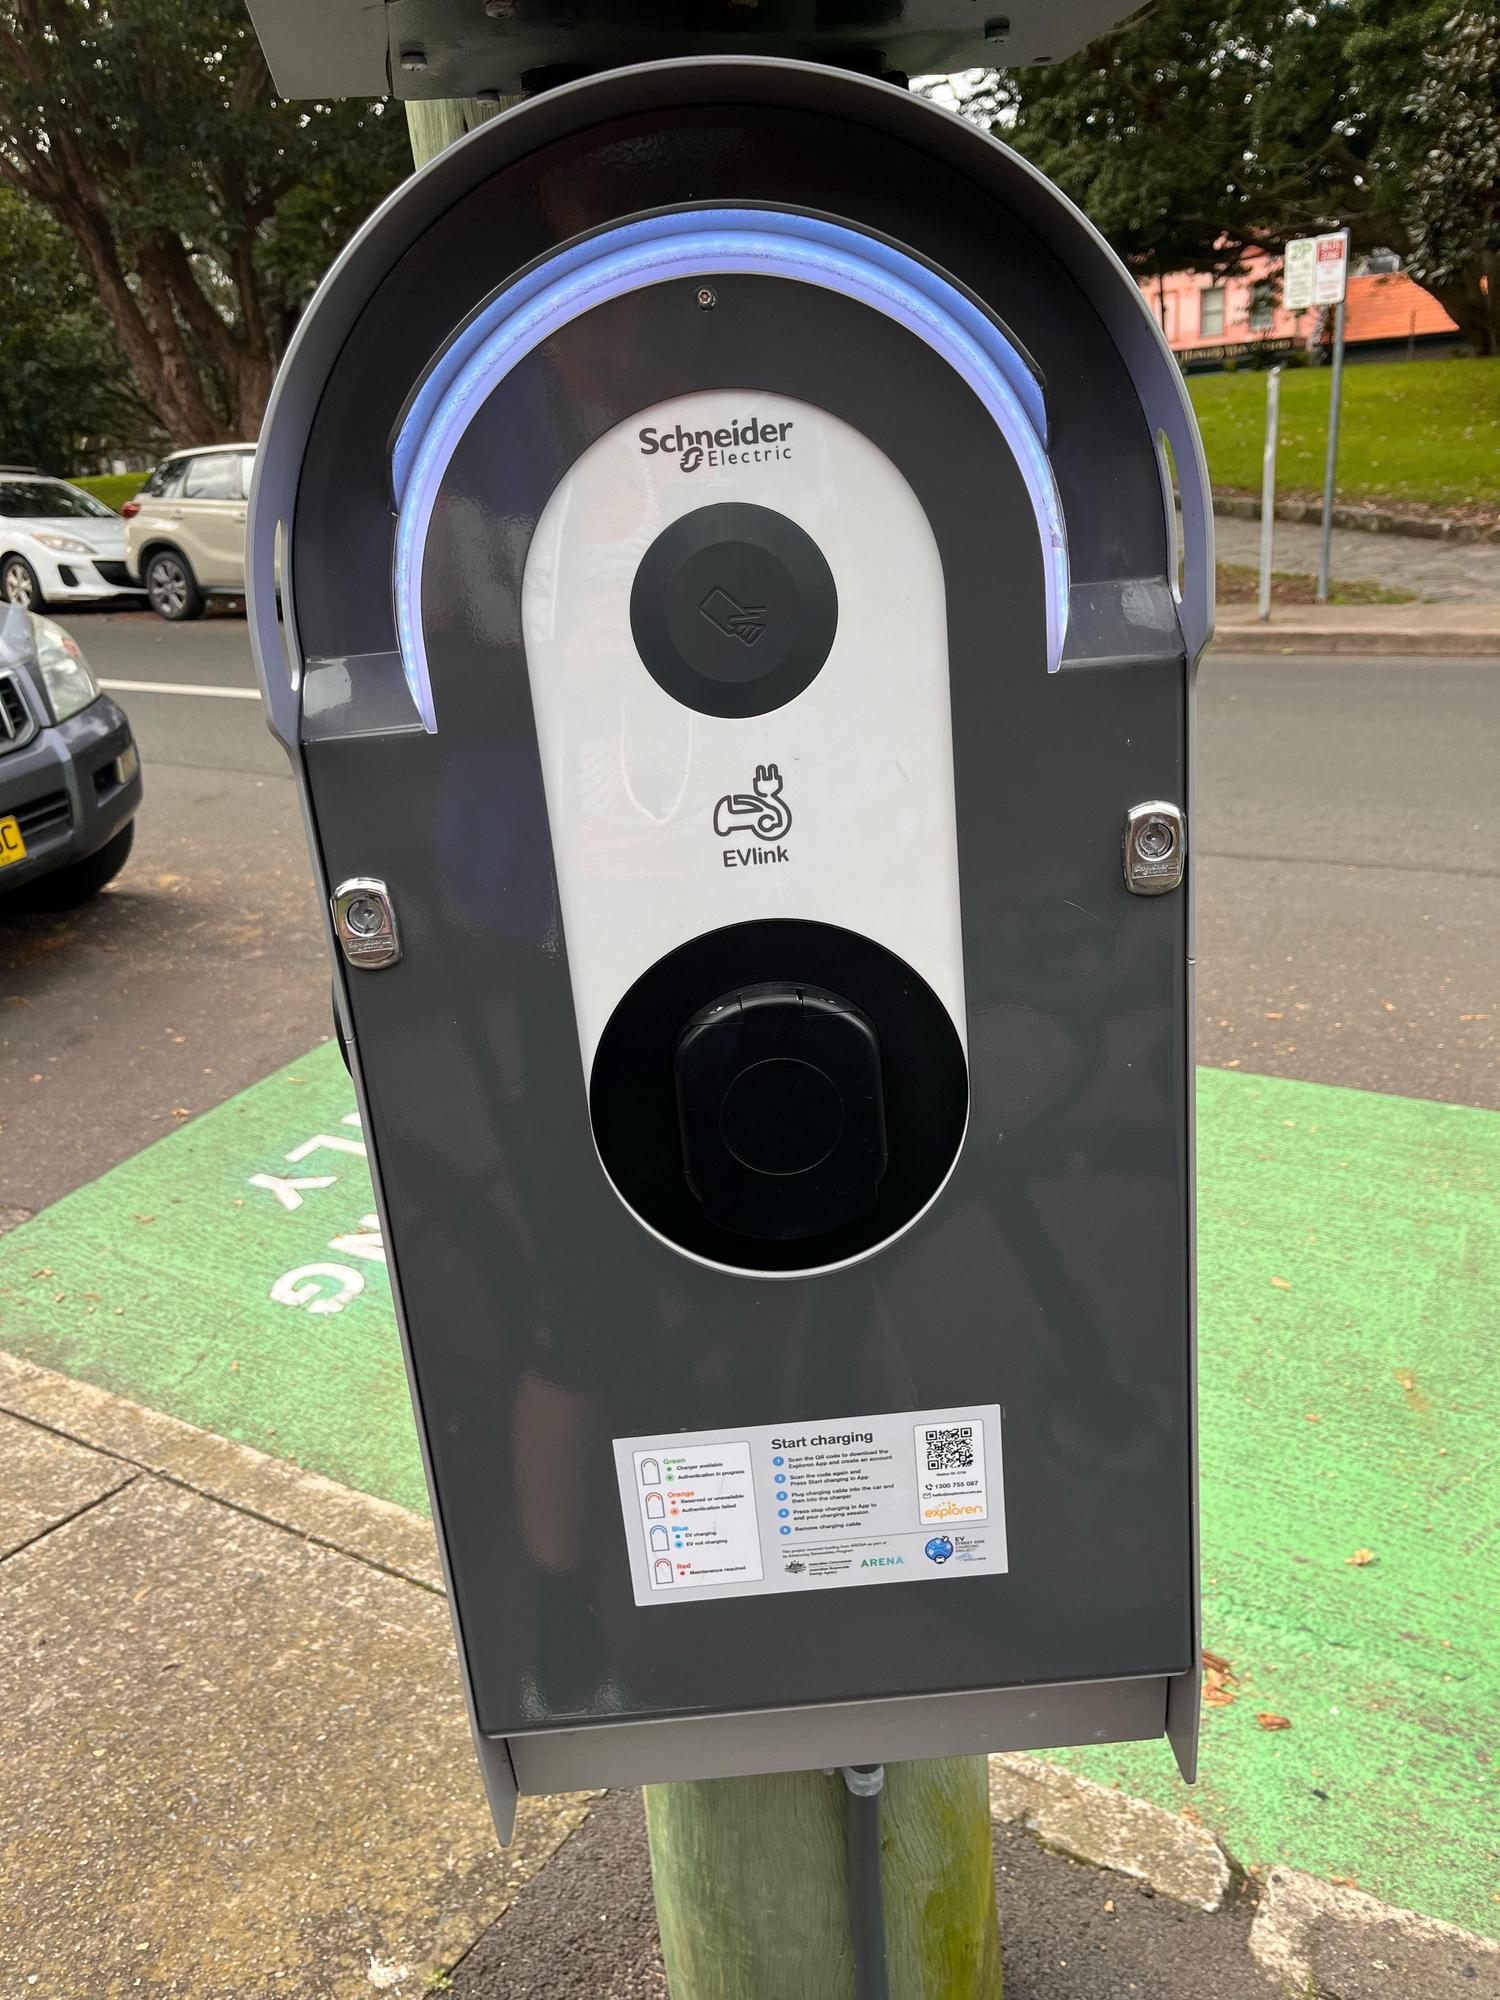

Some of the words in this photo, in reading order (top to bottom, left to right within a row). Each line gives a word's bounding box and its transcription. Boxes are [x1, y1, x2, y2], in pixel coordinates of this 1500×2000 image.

[638, 417, 794, 455] Schneider
[708, 445, 792, 467] Electric
[0, 824, 18, 855] C
[723, 845, 790, 867] EVlink
[771, 1437, 807, 1450] Start
[810, 1432, 873, 1446] charging
[682, 1505, 720, 1513] Authentication
[924, 1505, 983, 1519] exploren
[860, 1556, 904, 1568] ARENA
